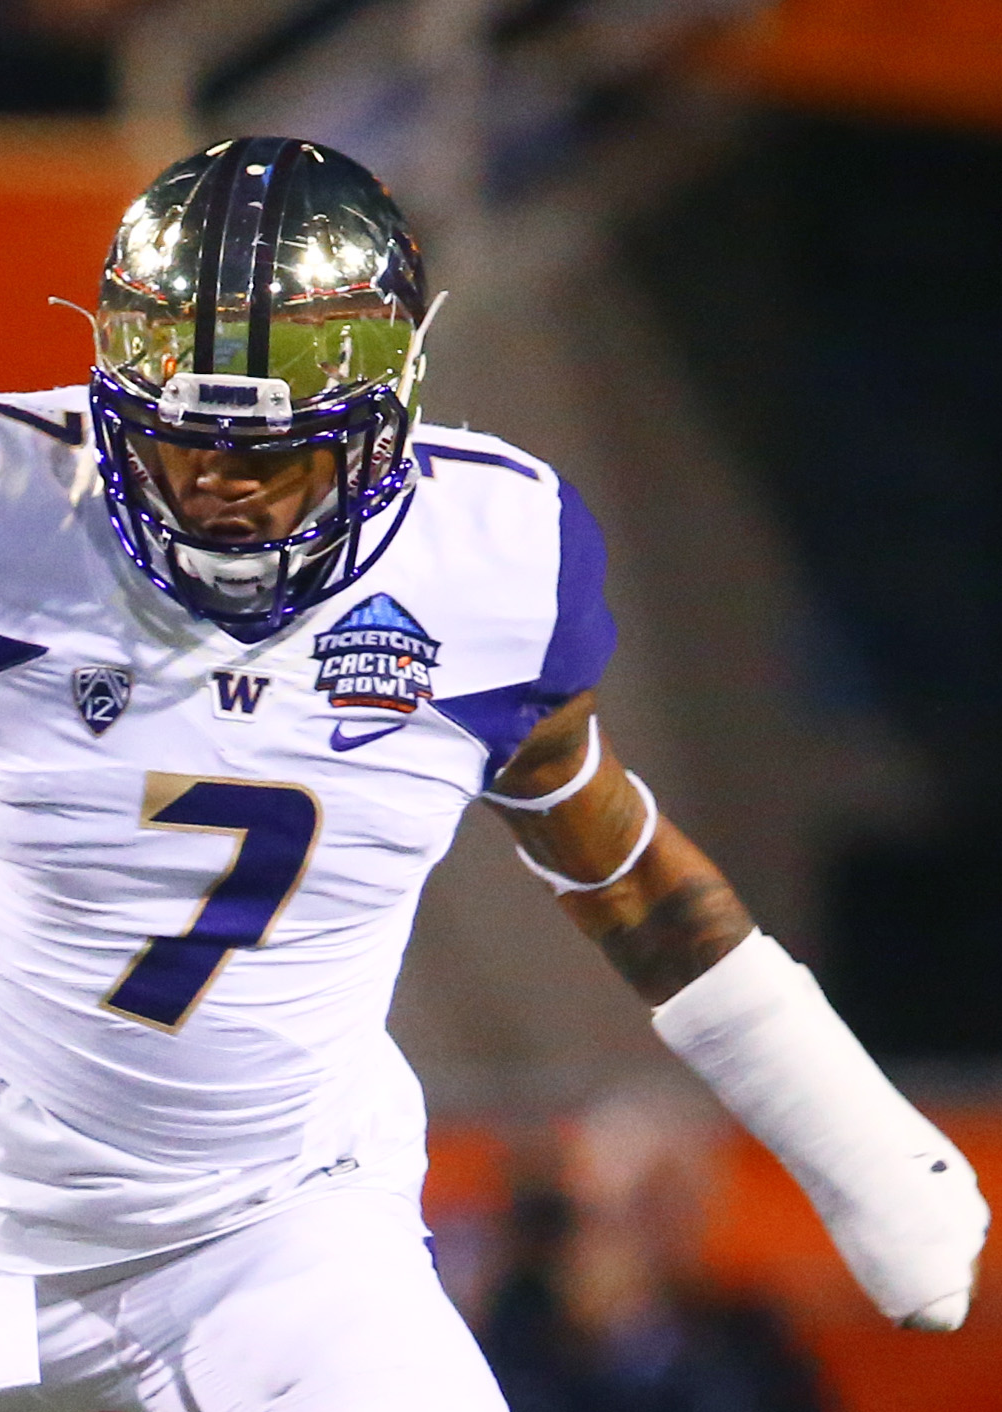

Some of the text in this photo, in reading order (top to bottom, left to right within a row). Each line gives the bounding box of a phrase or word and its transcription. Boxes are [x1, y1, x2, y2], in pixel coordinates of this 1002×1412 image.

[318, 630, 436, 660] TICKETCITY
[321, 652, 429, 686] CACTUS
[213, 671, 270, 714] W
[335, 676, 415, 700] BOWL
[85, 696, 115, 721] 12
[97, 770, 325, 1036] 7
